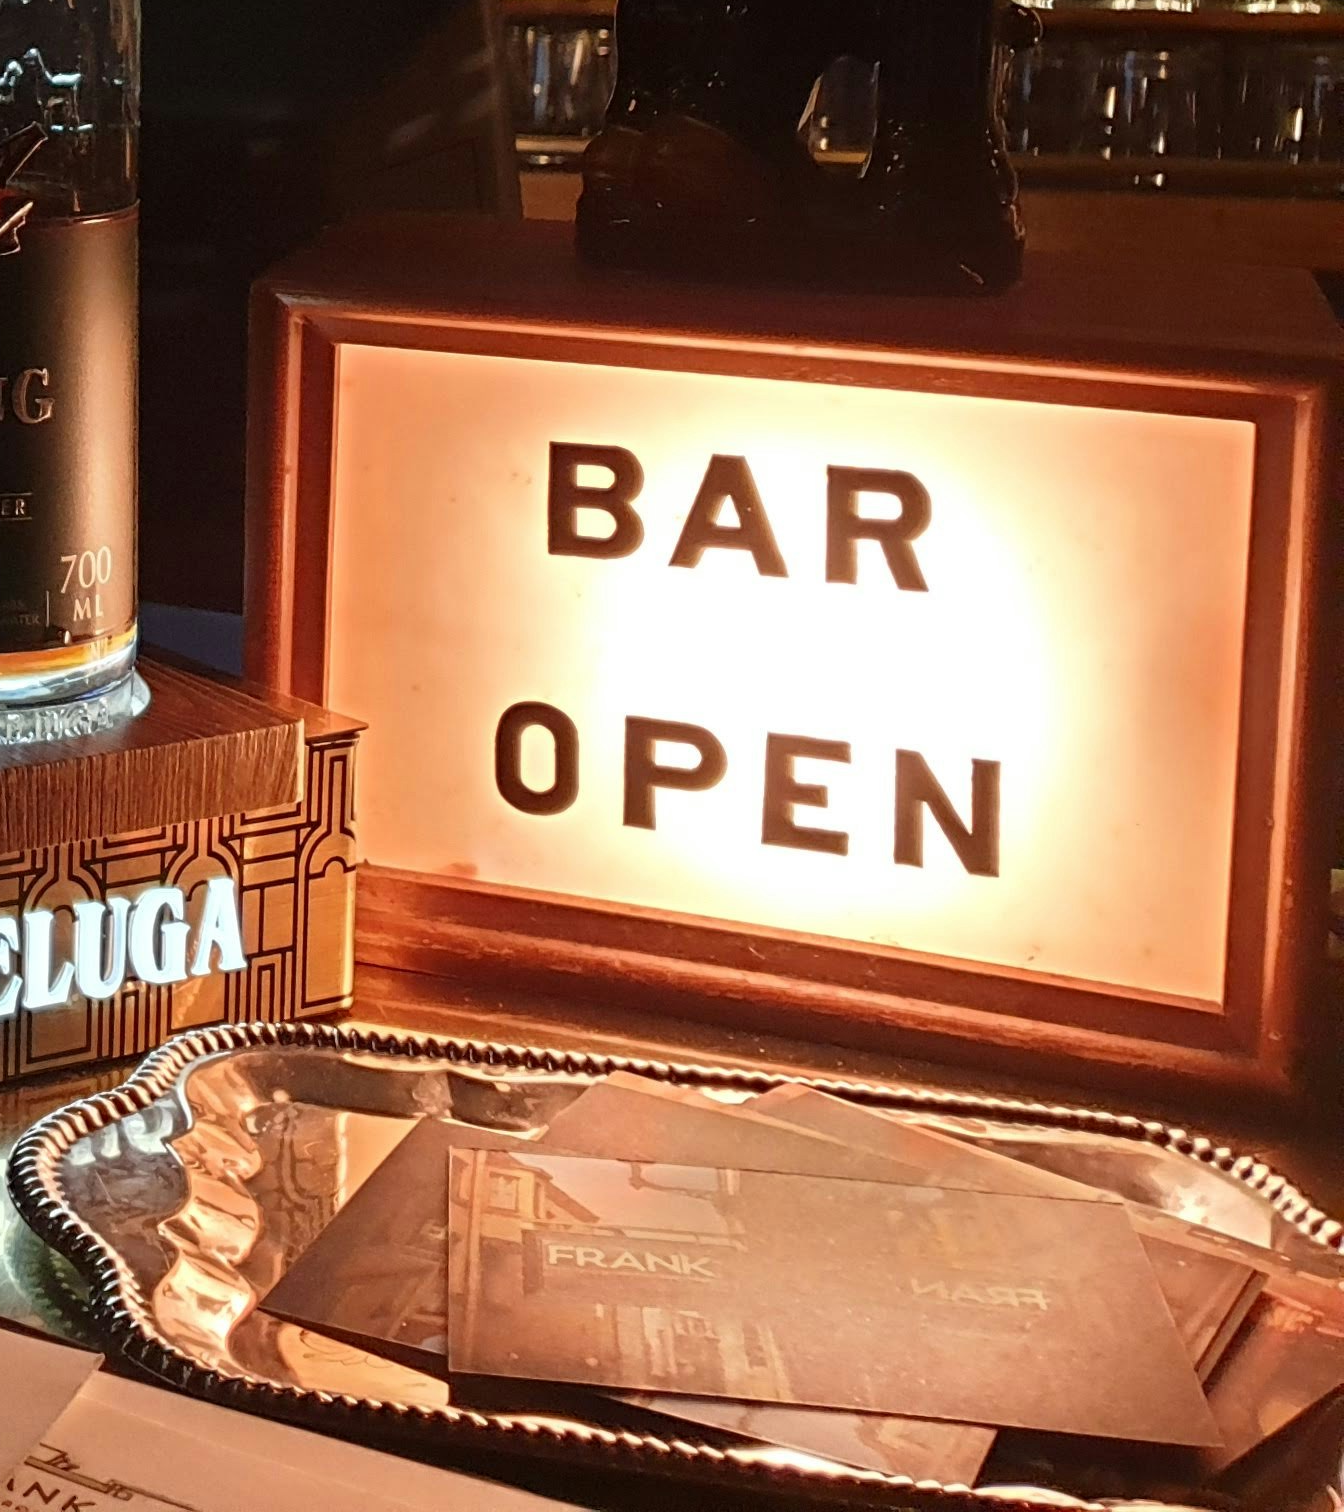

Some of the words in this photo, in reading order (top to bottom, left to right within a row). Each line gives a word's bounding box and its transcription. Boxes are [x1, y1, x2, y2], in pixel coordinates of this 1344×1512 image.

[547, 440, 933, 593] BAR
[60, 545, 113, 595] 700
[72, 593, 105, 623] ML
[493, 700, 1002, 879] OPEN
[547, 1243, 716, 1278] FRANK
